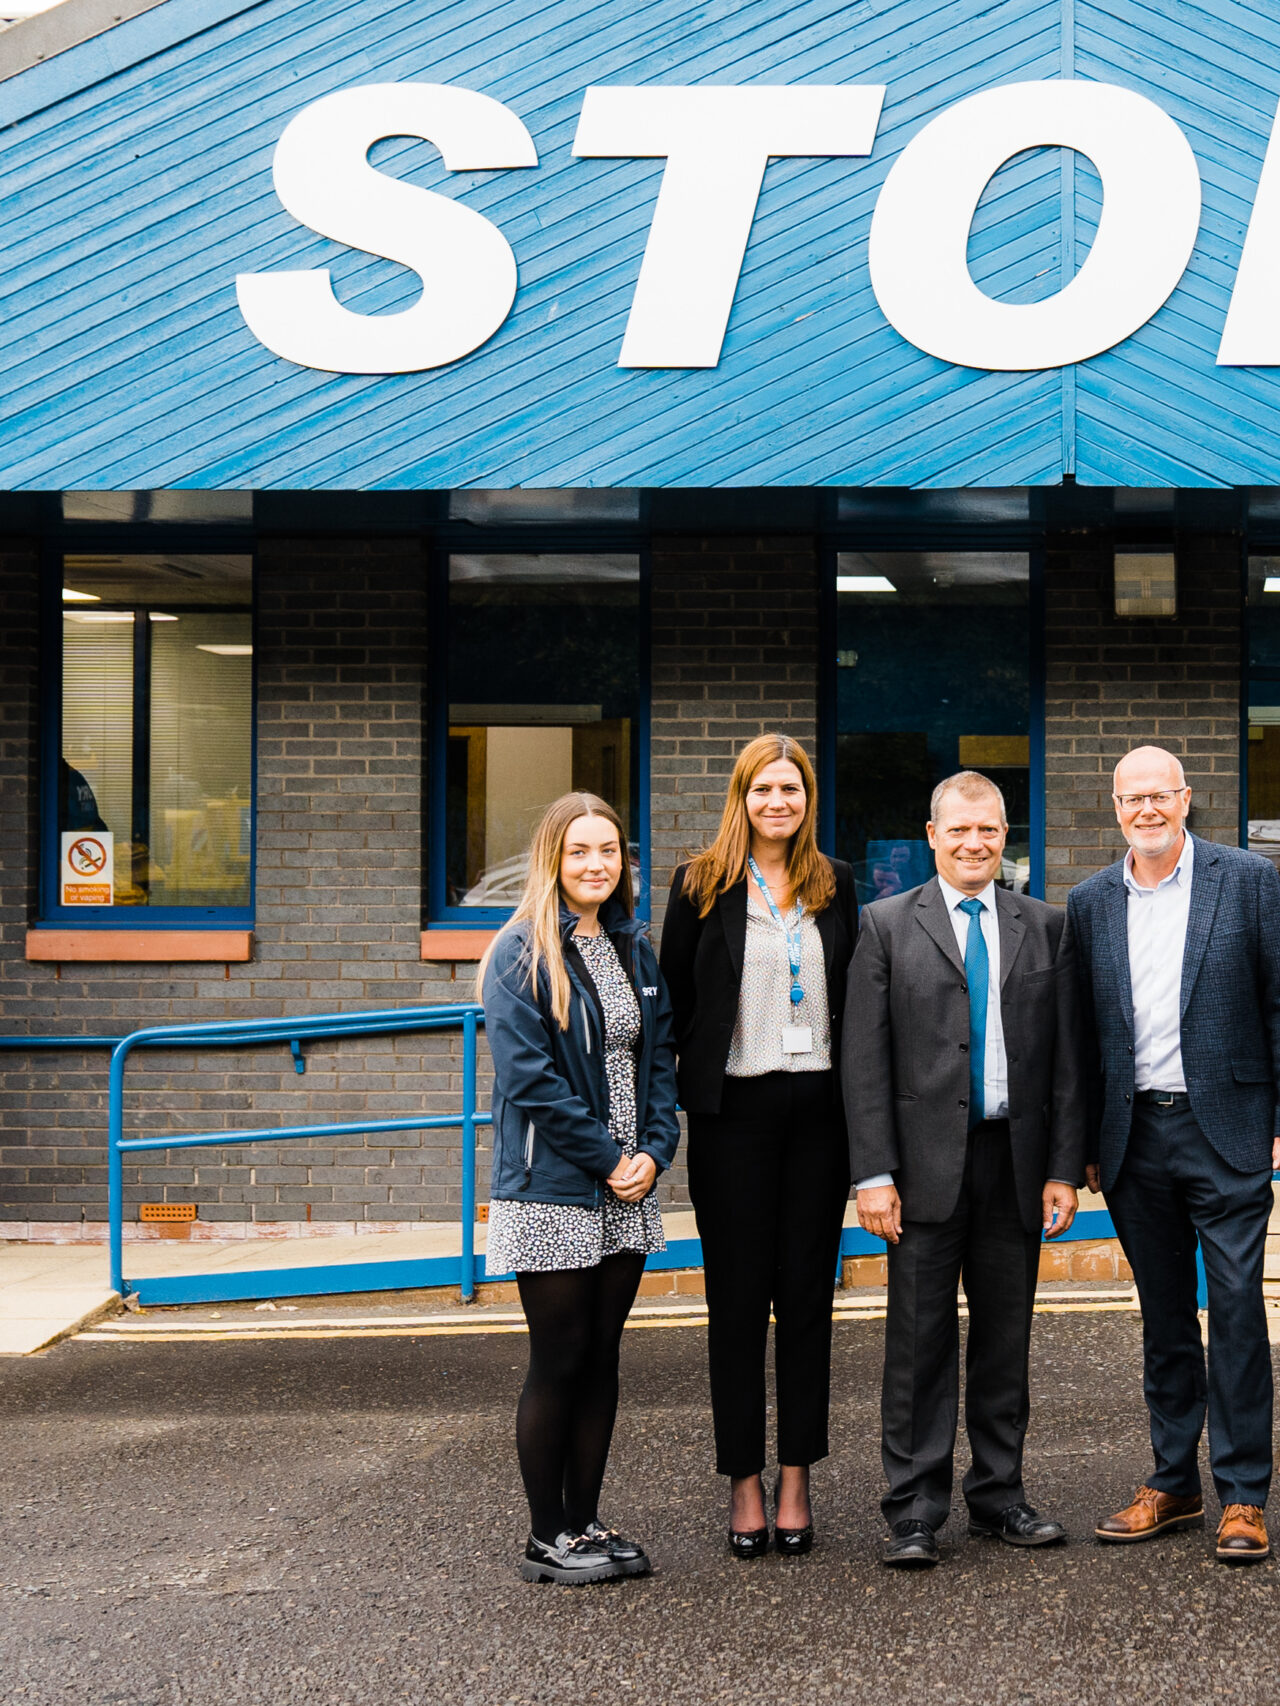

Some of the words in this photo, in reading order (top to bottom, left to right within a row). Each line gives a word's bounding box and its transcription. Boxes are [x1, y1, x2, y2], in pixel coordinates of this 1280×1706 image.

[749, 857, 762, 879] STORY
[65, 885, 77, 893] No
[78, 885, 110, 895] smoking
[761, 885, 776, 906] STORY
[79, 894, 105, 903] vaping
